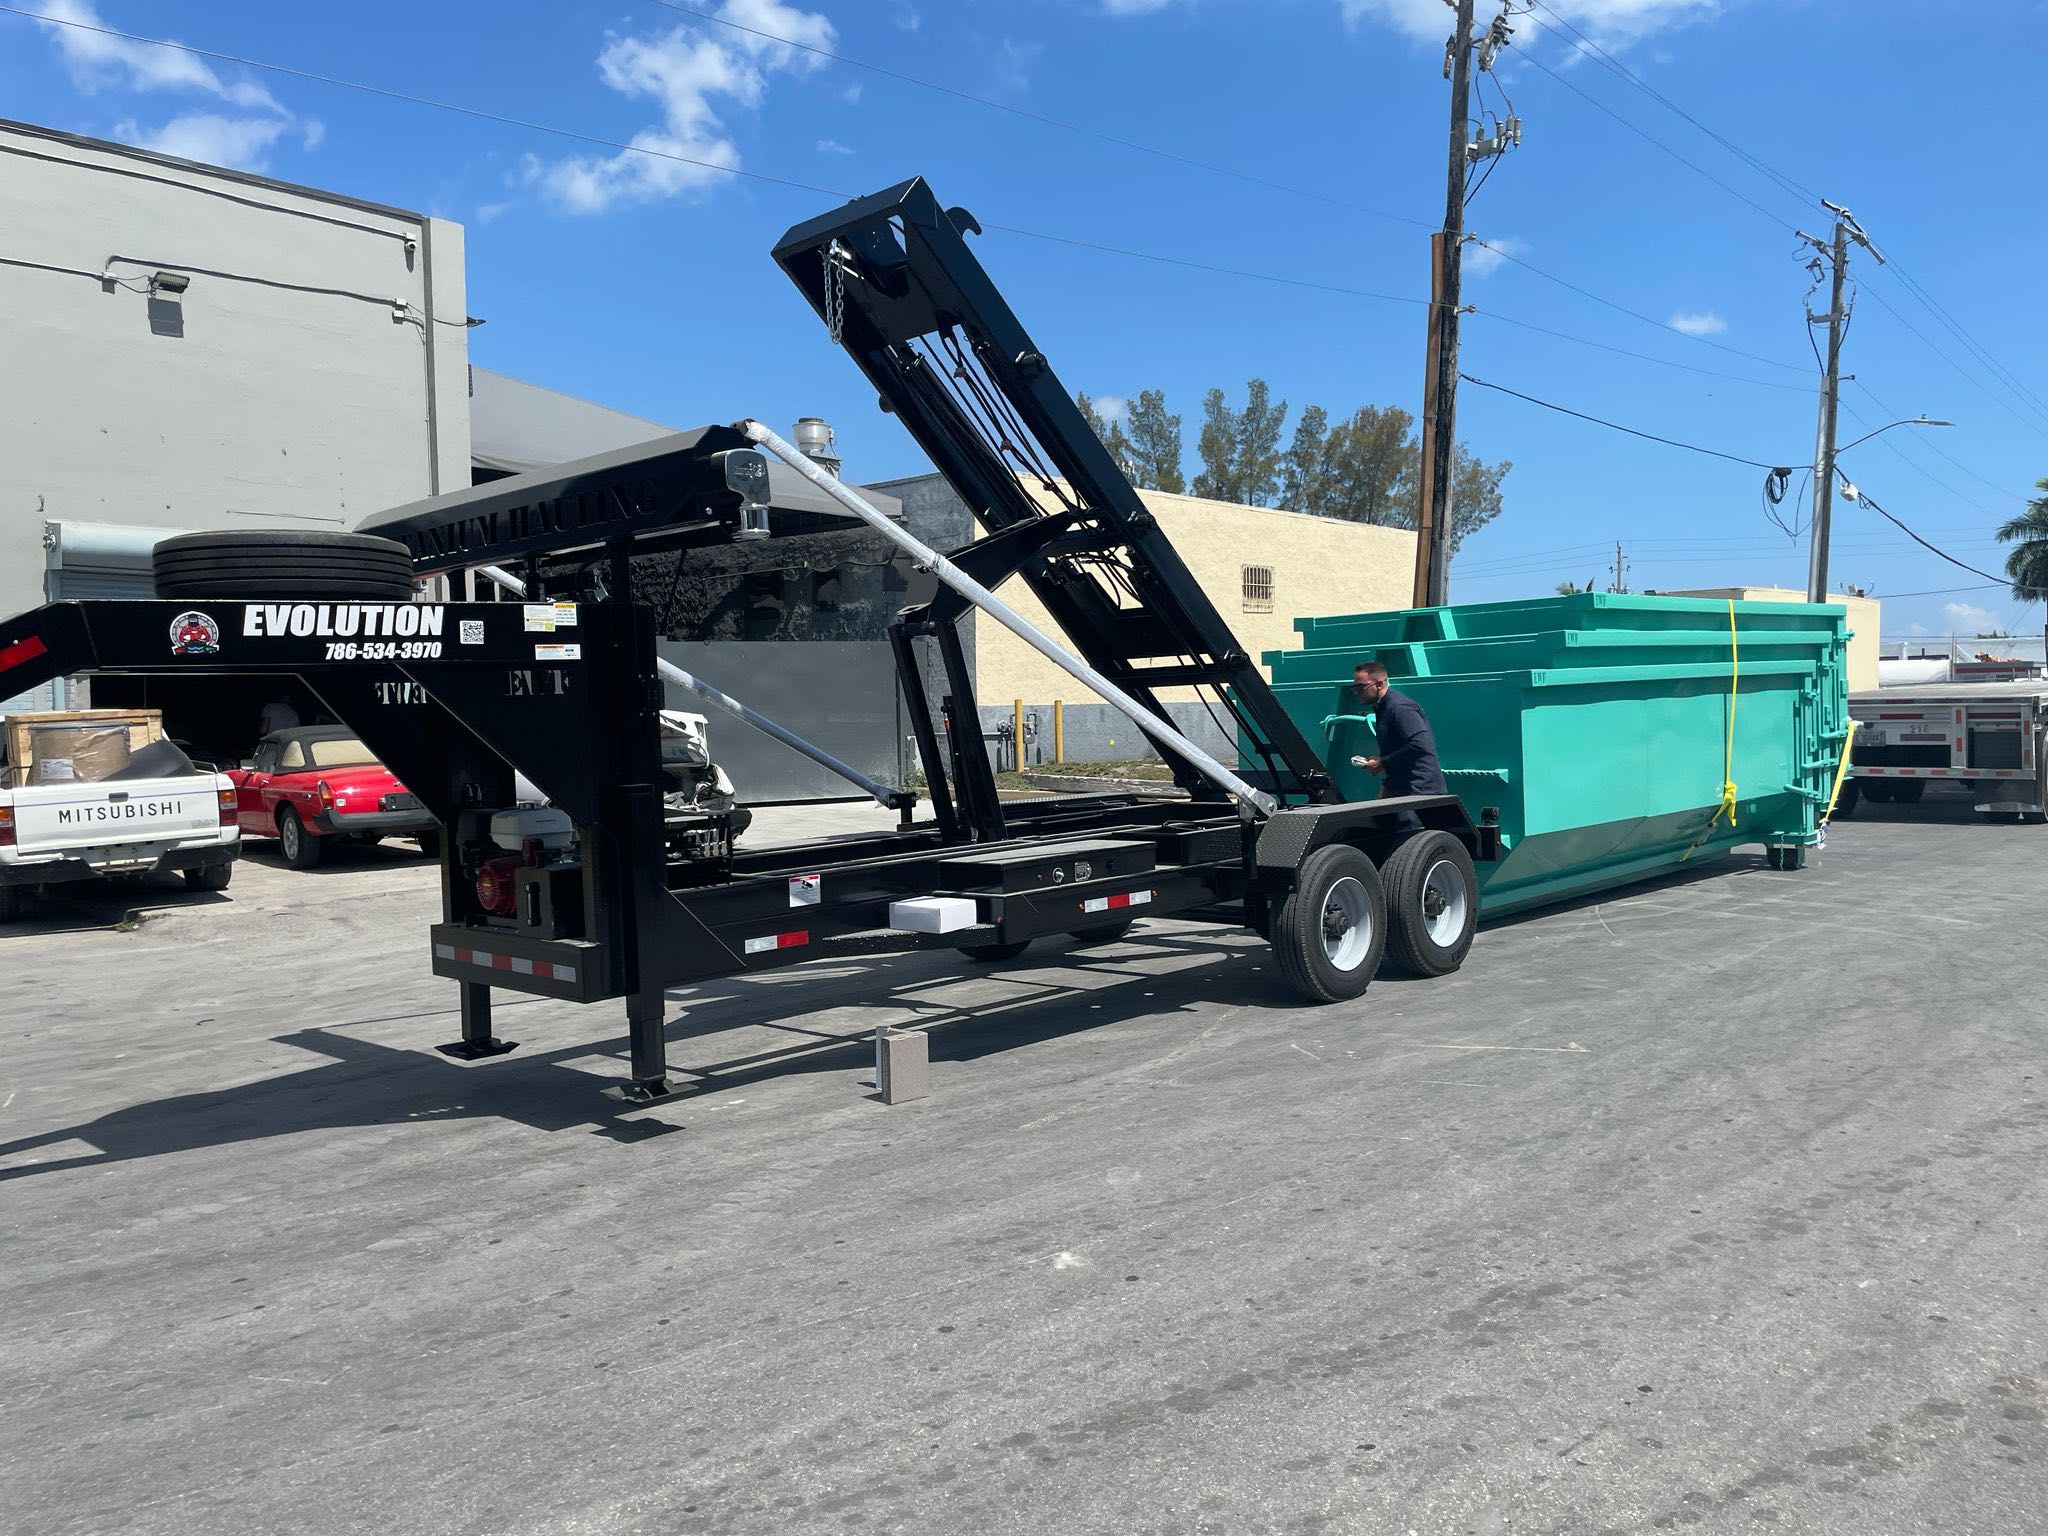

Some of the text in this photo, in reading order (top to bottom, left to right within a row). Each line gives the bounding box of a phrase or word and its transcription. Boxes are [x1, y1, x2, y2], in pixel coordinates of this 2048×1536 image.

[401, 480, 656, 563] ANIUM HAULING
[243, 604, 444, 637] EVOLUTION
[325, 641, 442, 660] 786-534-3970
[58, 801, 182, 824] MITSUBISHI
